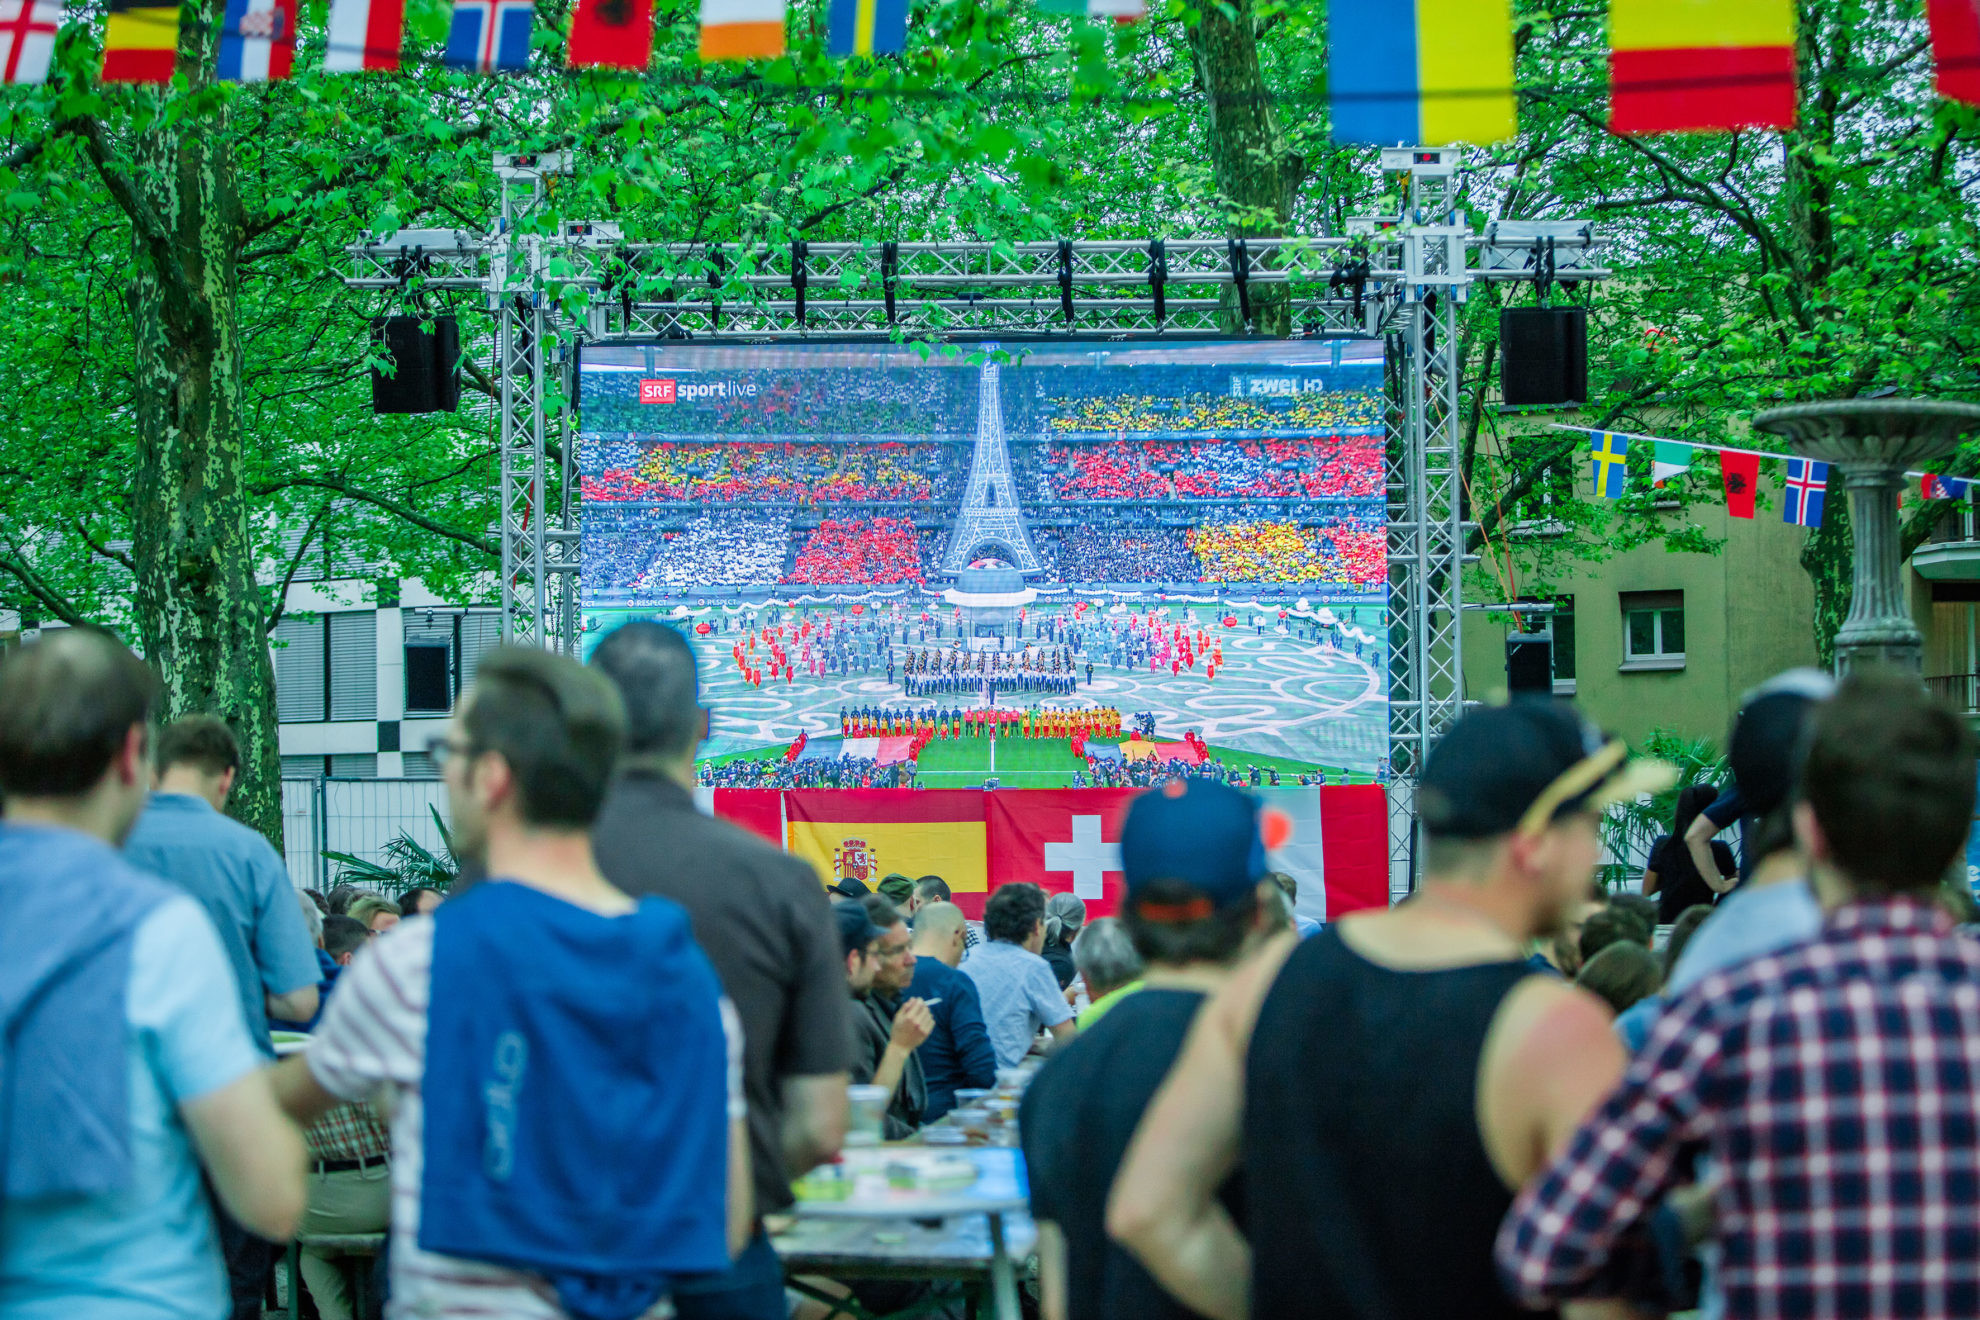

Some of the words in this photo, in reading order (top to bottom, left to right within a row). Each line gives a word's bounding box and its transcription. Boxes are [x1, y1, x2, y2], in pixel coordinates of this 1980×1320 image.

[644, 385, 672, 398] SRF
[637, 599, 667, 607] RESPECT
[707, 598, 736, 606] RESPECT
[1054, 596, 1082, 604] RESPECT
[1259, 595, 1290, 603] RESPECT
[1331, 595, 1363, 603] RESPECT
